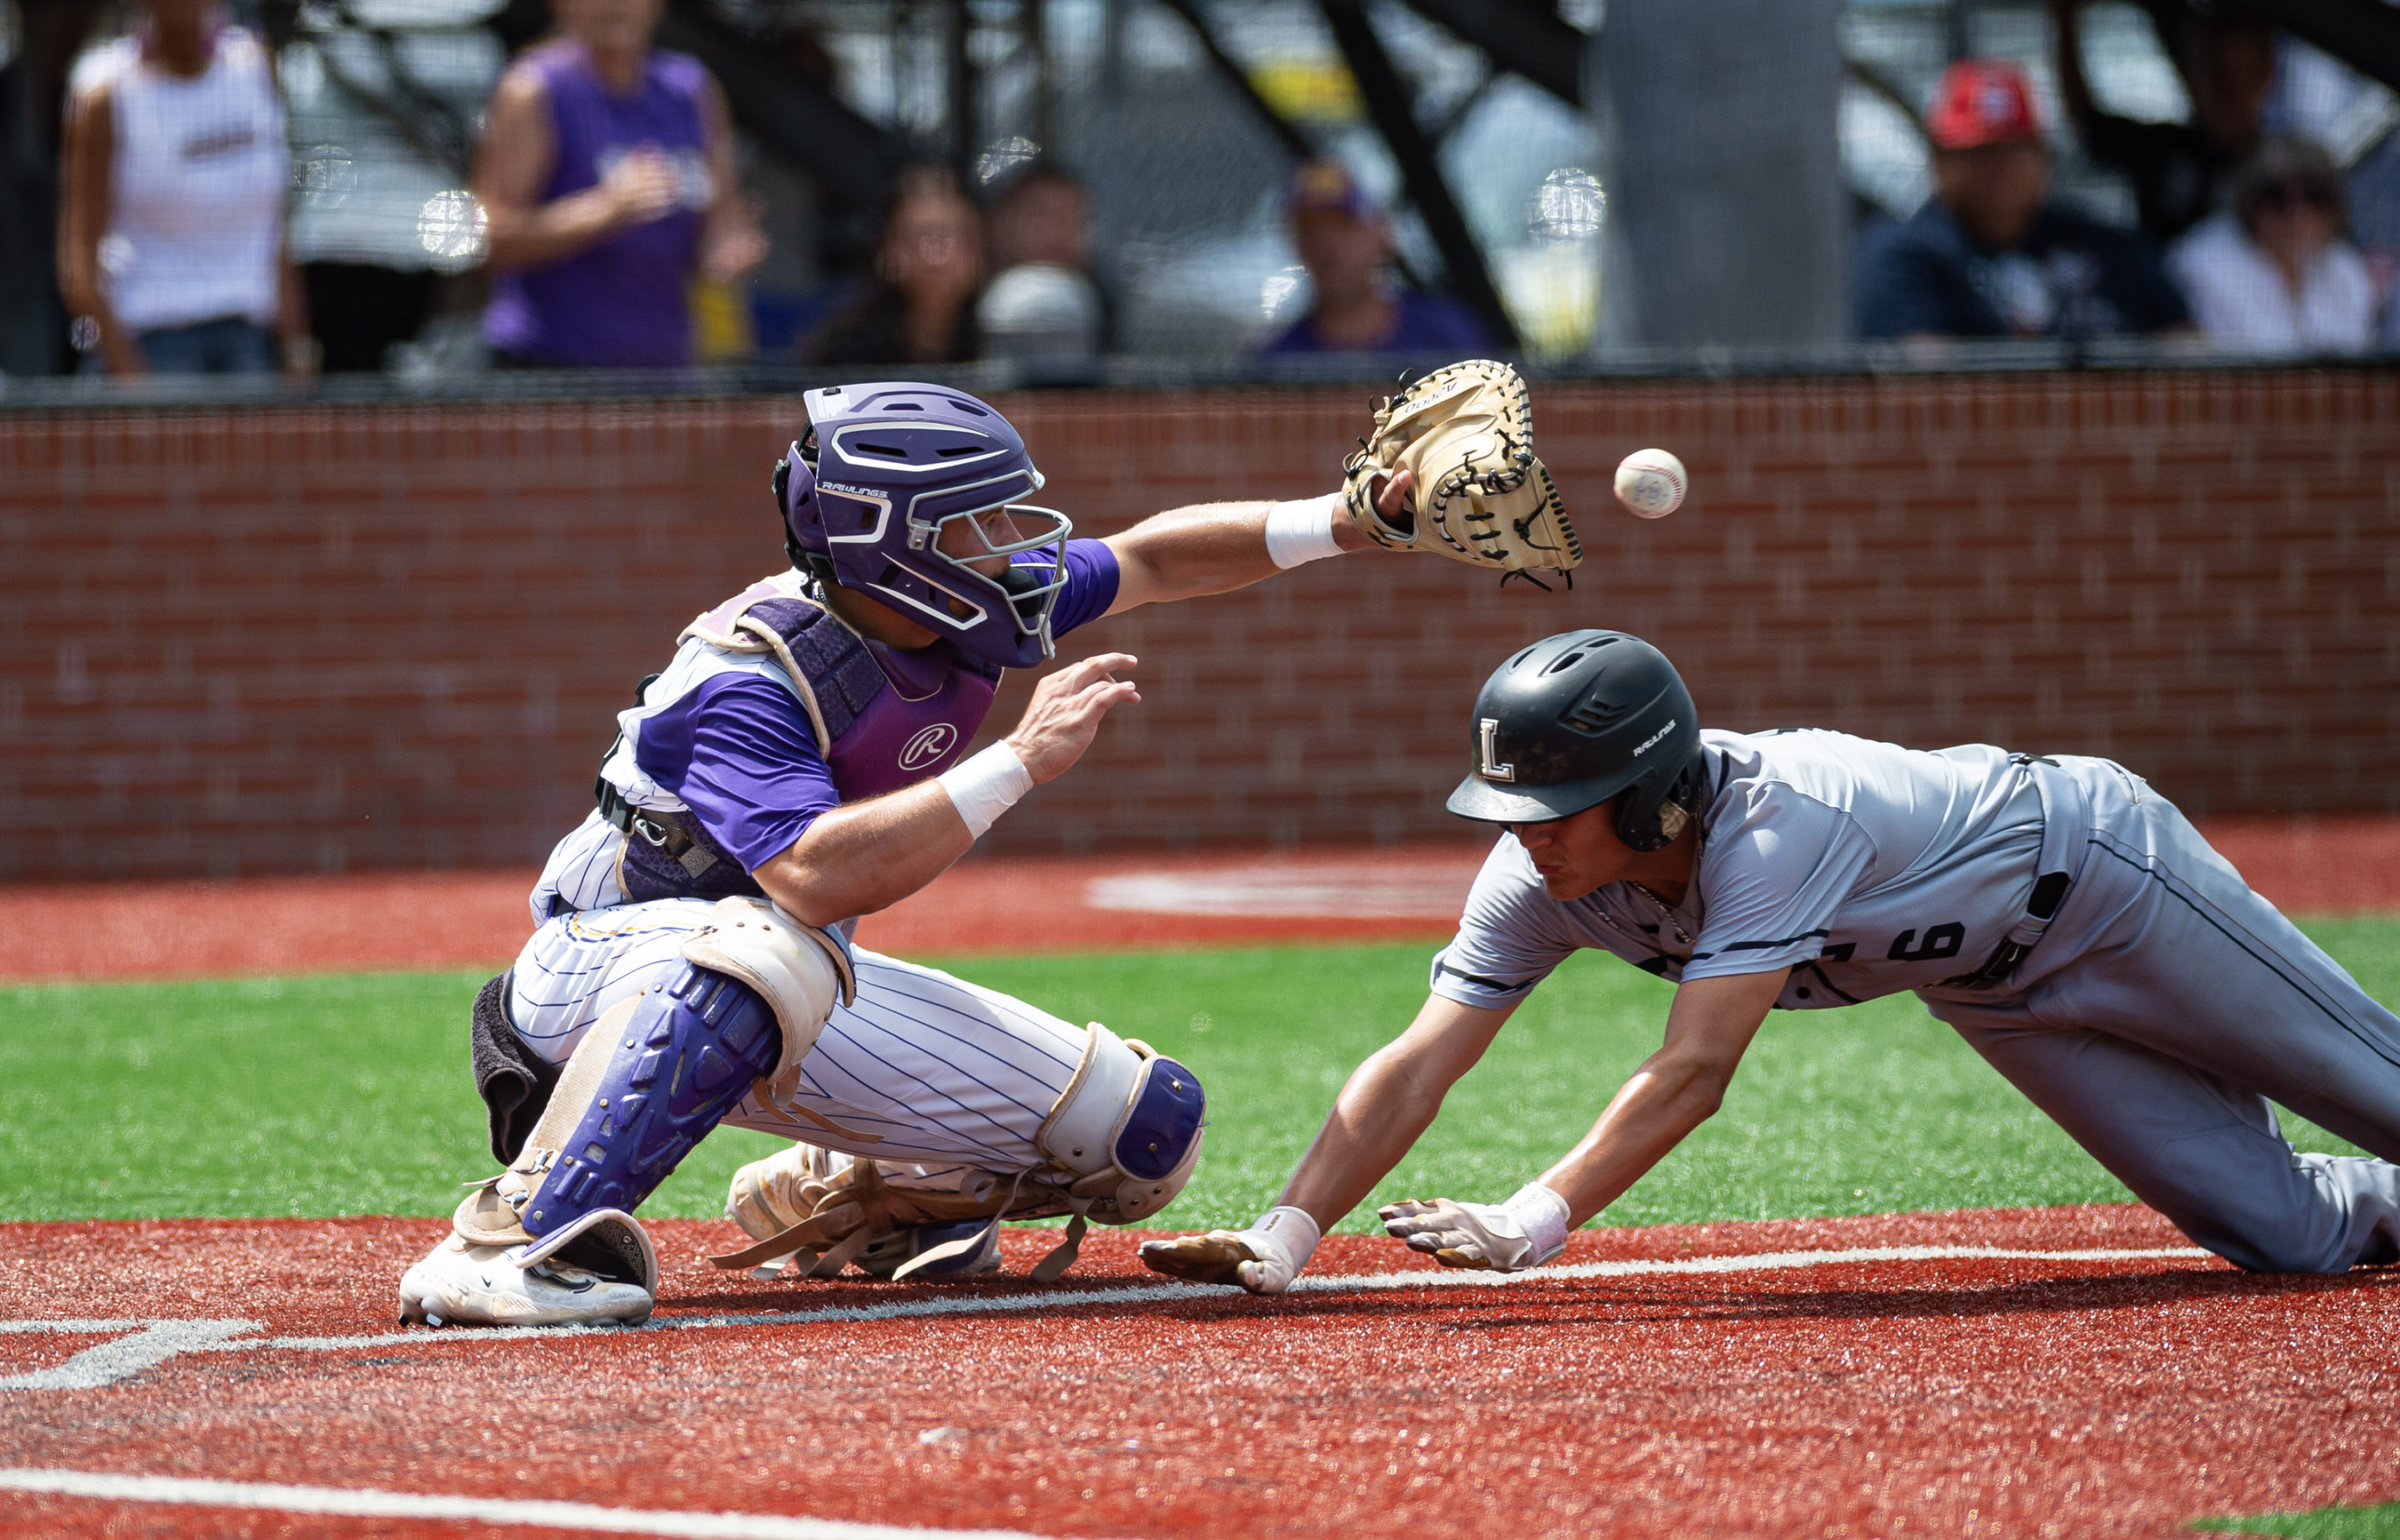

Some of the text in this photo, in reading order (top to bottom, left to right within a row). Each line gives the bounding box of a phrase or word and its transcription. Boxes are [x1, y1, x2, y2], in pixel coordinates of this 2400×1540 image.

[822, 481, 889, 499] RAWLINGS
[904, 727, 946, 764] R
[1480, 717, 1516, 782] L
[1633, 719, 1676, 757] RAWLINGS
